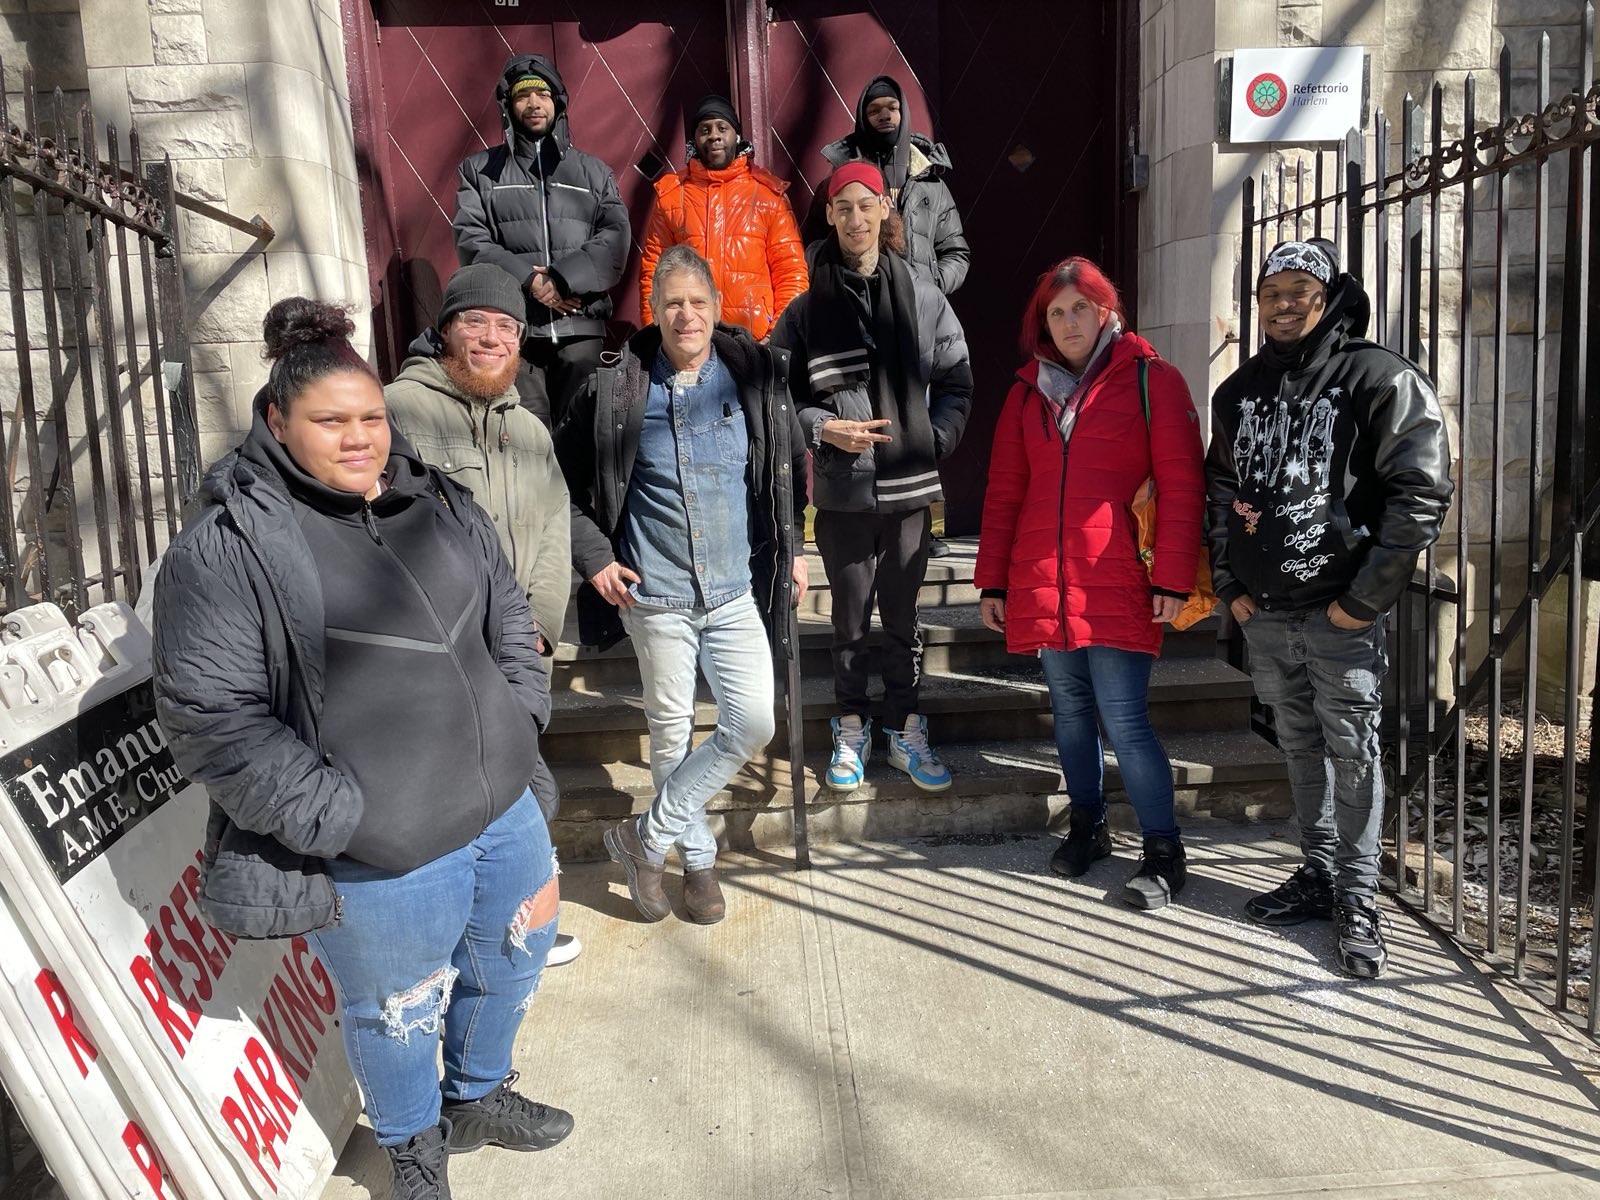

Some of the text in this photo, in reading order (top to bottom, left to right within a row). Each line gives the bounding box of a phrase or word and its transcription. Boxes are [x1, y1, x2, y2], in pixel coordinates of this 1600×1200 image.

[1293, 82, 1349, 94] Refettorio
[1292, 95, 1328, 106] Harlem
[1275, 493, 1331, 517] Speak No
[1289, 509, 1316, 525] Evil
[1284, 522, 1331, 547] See No
[1294, 537, 1321, 554] Evil
[1280, 553, 1335, 573] Hear No
[1295, 567, 1321, 582] Evil
[62, 791, 136, 867] A.M.E.
[130, 848, 238, 1060] RESER
[220, 935, 337, 1195] PARKING
